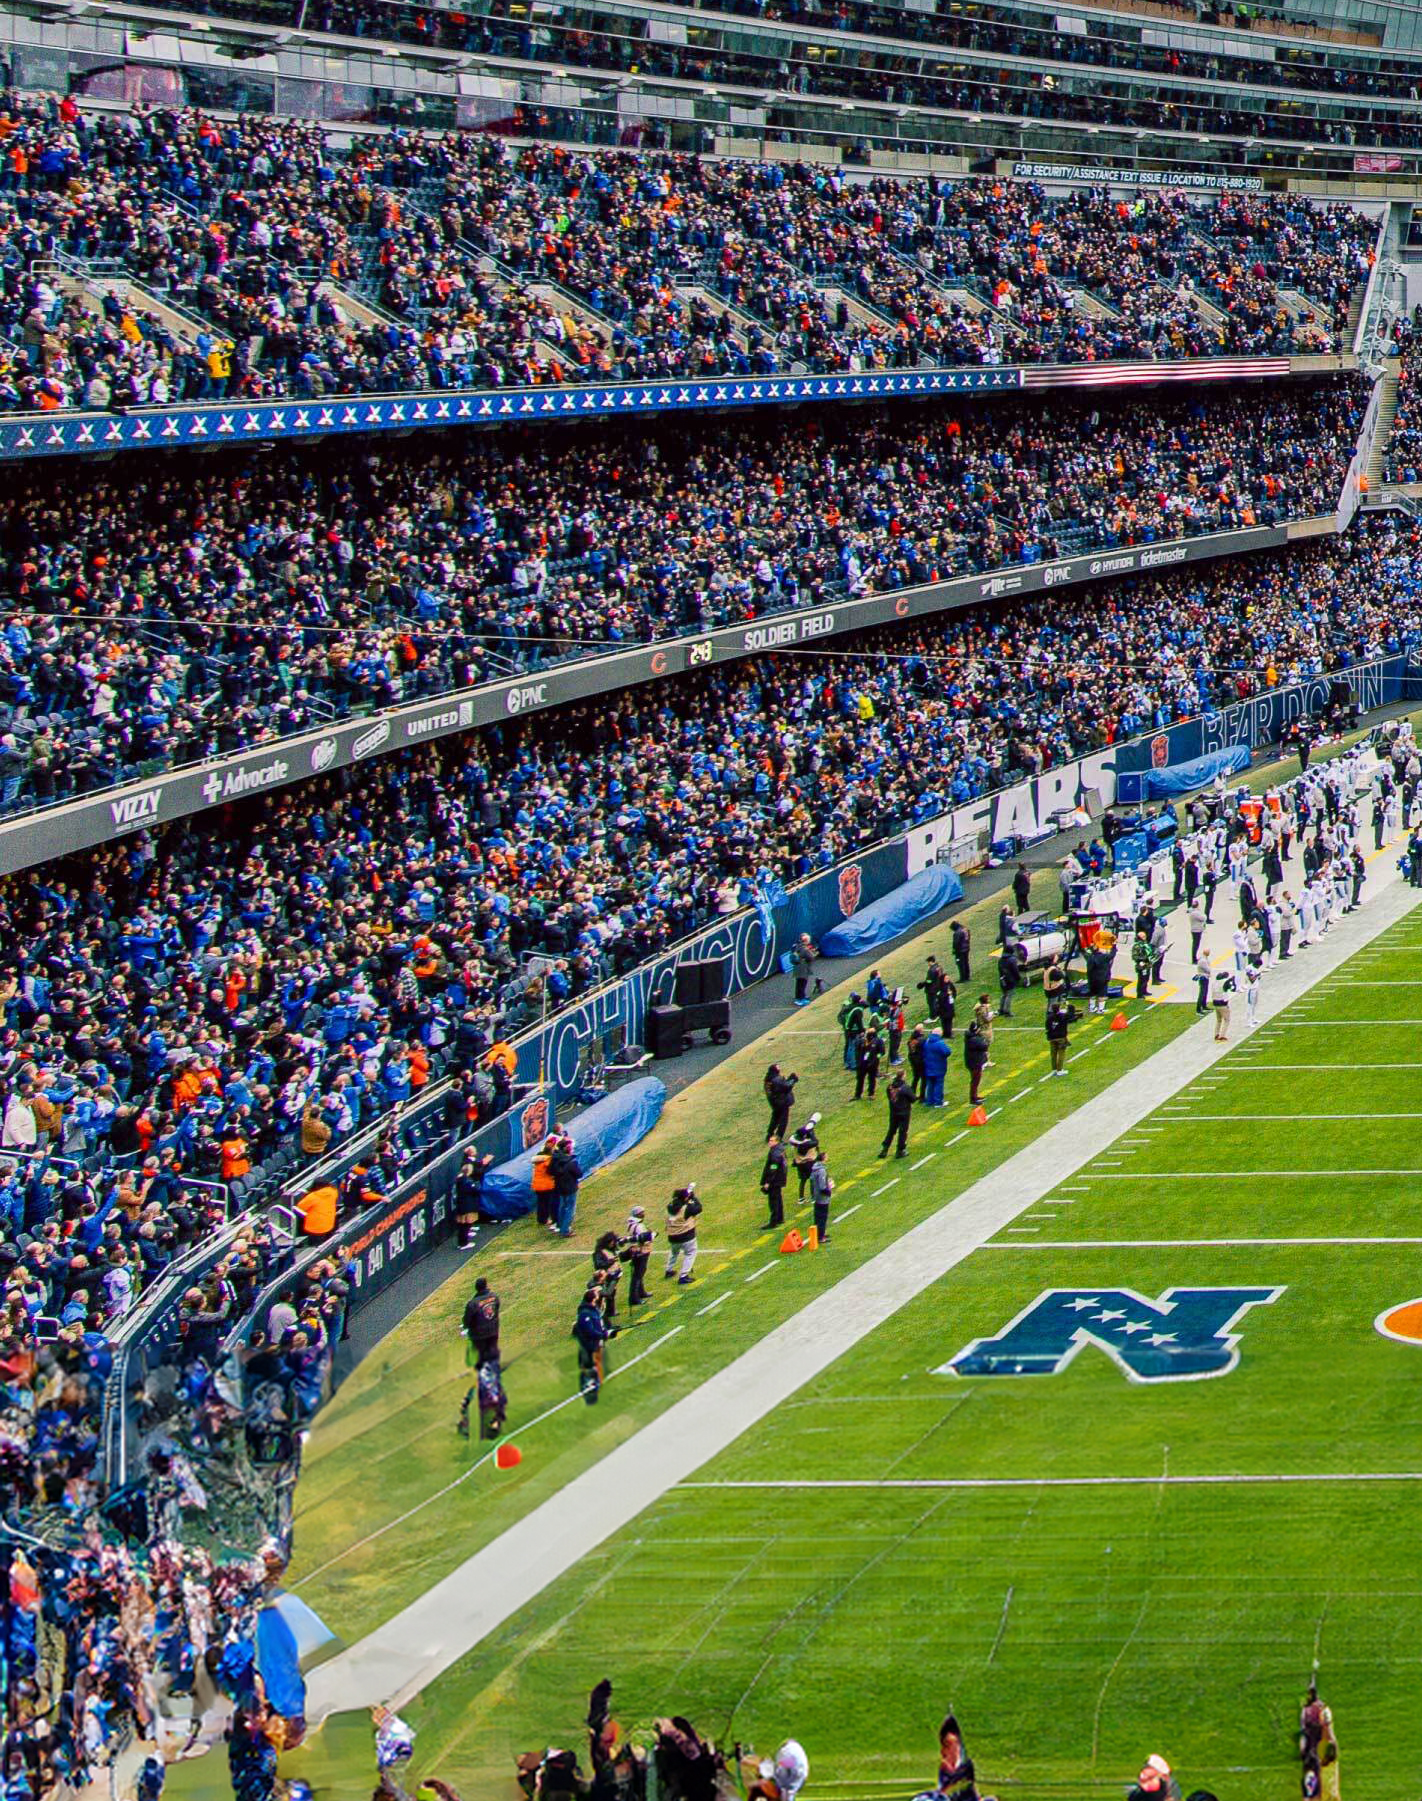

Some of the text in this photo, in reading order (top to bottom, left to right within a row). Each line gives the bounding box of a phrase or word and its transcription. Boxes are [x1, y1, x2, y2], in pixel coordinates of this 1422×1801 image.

[1015, 163, 1032, 176] FOR
[1033, 165, 1118, 182] SECURITY/ASSISTANCE
[1120, 171, 1138, 182] TEXT
[1139, 172, 1161, 184] ISSUE
[1168, 174, 1205, 187] LOCATION
[1207, 177, 1216, 187] TO
[1053, 566, 1071, 583] PNC
[1102, 556, 1134, 572] HYUNDAI
[1140, 547, 1187, 567] ticketmaster
[744, 614, 834, 651] SOLDIER FIELD
[520, 684, 547, 708] PNC
[407, 711, 458, 736] UNITED
[1202, 694, 1274, 756] BEAR
[223, 760, 289, 797] Advocate
[111, 788, 162, 824] VIZZY
[906, 747, 1116, 878] BEARS
[548, 917, 776, 1089] CHICGO
[376, 1188, 427, 1236] CHAMPIONS
